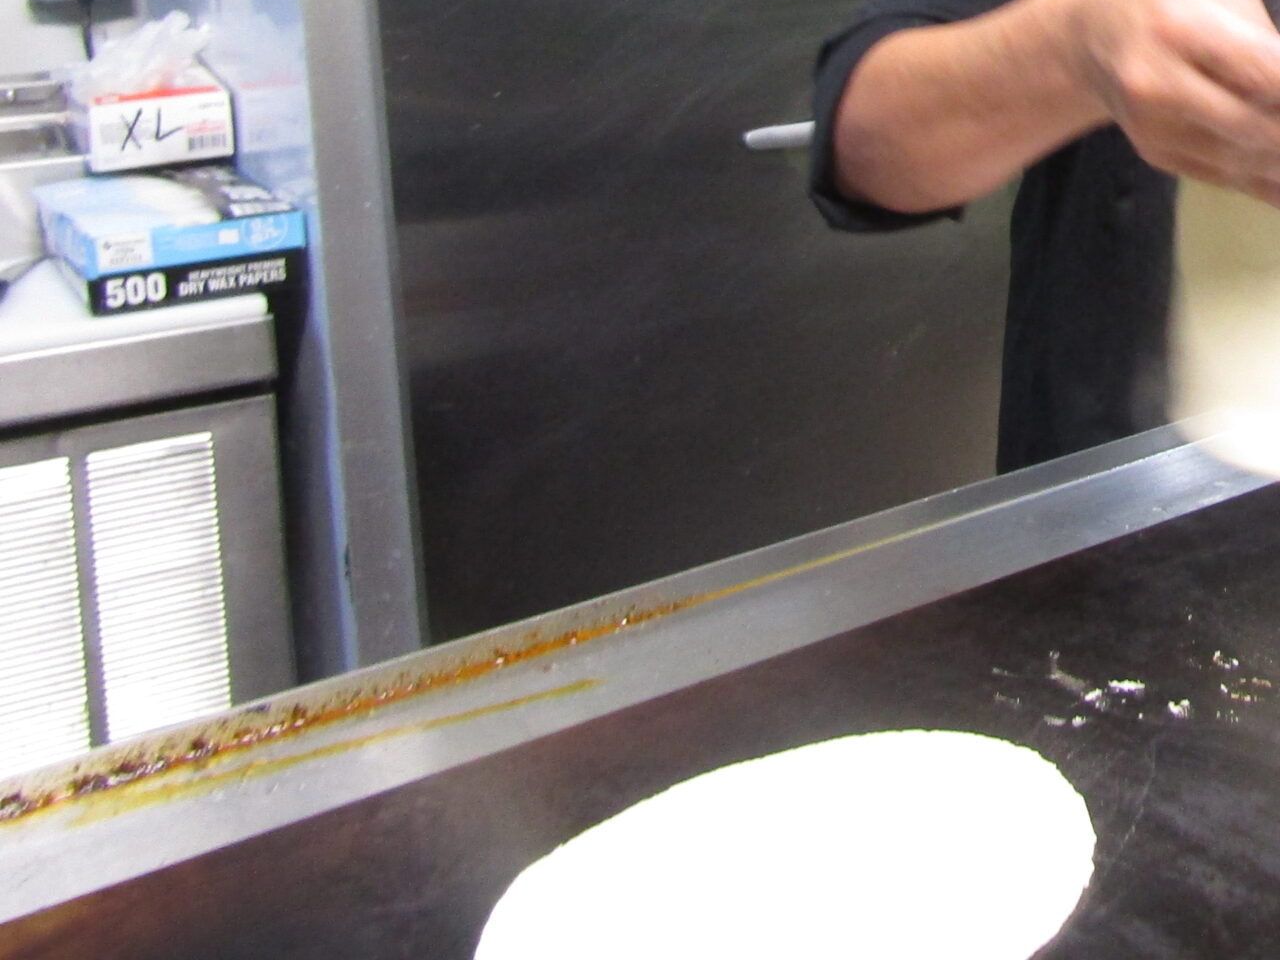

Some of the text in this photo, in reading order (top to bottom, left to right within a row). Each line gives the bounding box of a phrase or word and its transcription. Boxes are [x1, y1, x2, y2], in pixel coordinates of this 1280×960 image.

[105, 272, 167, 309] 500
[178, 267, 287, 297] DRY WAX PAPERS
